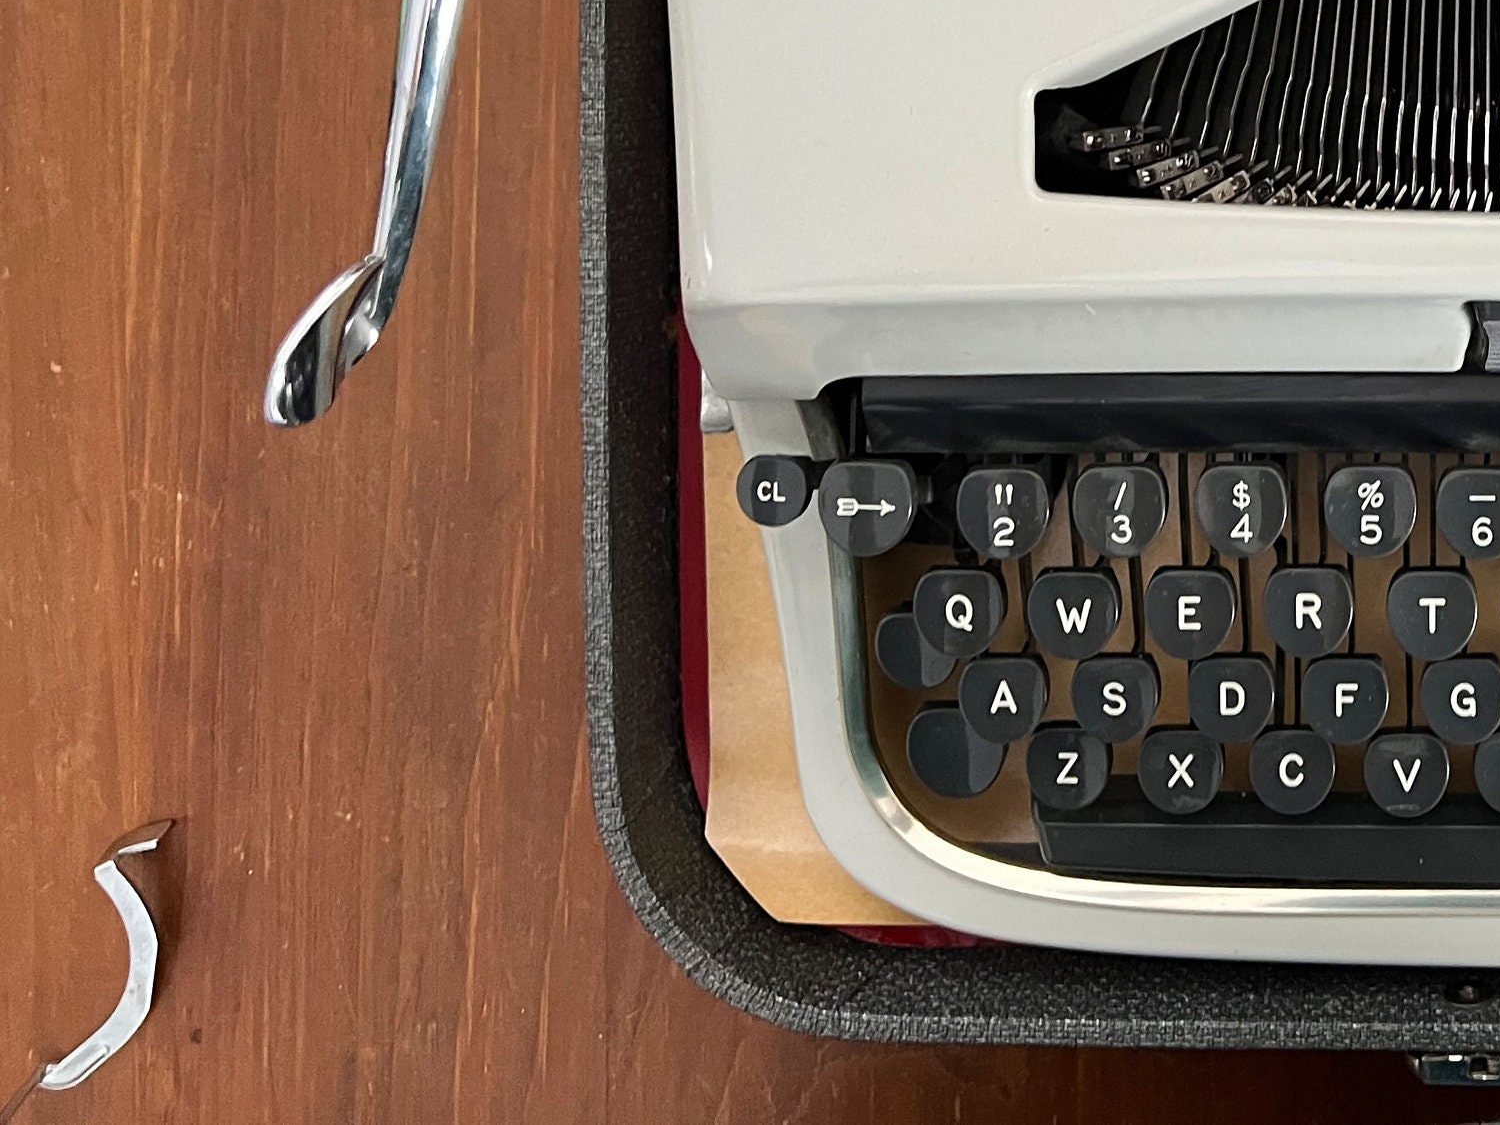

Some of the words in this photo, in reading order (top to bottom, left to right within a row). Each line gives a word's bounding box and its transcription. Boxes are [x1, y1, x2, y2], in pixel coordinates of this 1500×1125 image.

[757, 480, 786, 502] CL
[1113, 481, 1127, 511] /
[1232, 480, 1251, 511] $
[1357, 479, 1384, 511] %
[993, 516, 1015, 547] 2
[1111, 514, 1133, 544] 3
[1230, 514, 1254, 544] 4
[1359, 514, 1383, 545] 5
[1471, 516, 1493, 547] 6
[945, 594, 973, 632] Q
[1055, 598, 1092, 634] W
[1178, 595, 1202, 631] E
[1295, 592, 1322, 630] R
[1418, 597, 1446, 634] T
[990, 680, 1017, 714] A
[1102, 682, 1127, 716] S
[1219, 681, 1245, 716] D
[1335, 683, 1359, 718] F
[1450, 682, 1477, 717] G
[1056, 752, 1079, 784] Z
[1167, 753, 1194, 788] X
[1279, 753, 1304, 788] C
[1393, 758, 1421, 793] V
